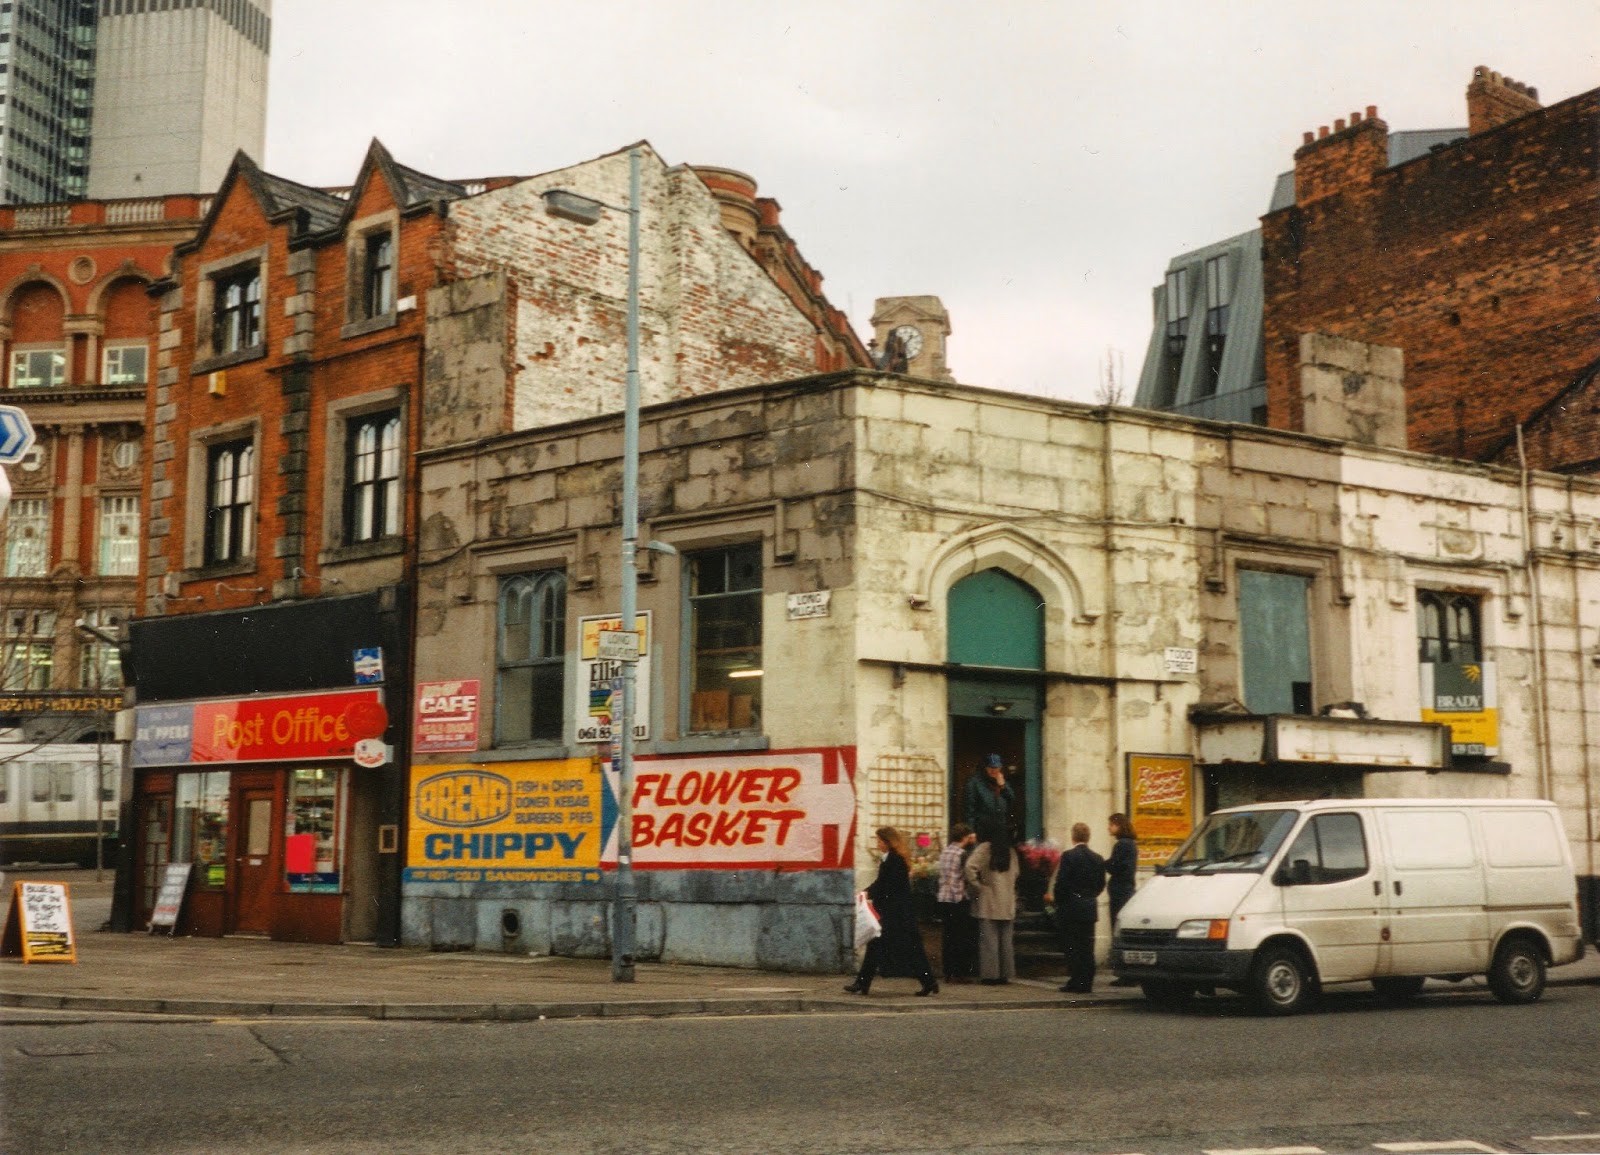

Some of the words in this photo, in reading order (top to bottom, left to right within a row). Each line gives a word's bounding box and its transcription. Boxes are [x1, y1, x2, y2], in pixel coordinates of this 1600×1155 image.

[796, 593, 822, 606] LONG
[789, 603, 826, 616] MILLGATE
[612, 620, 623, 631] LE
[607, 634, 630, 645] LONG
[600, 646, 638, 658] MILLGATE
[1169, 649, 1193, 660] TODD
[1164, 659, 1194, 671] STREET
[418, 695, 476, 714] CAFE
[1436, 695, 1482, 708] BRADY
[212, 712, 265, 749] Post
[271, 708, 349, 745] Office
[578, 726, 597, 739] 061
[516, 781, 539, 792] FISH
[552, 779, 583, 791] CHIPS
[631, 768, 802, 808] FLOWER
[418, 774, 509, 823] ARENA
[516, 797, 549, 808] DONER
[554, 796, 589, 807] KEBAB
[515, 812, 564, 824] BURGERS
[570, 811, 593, 823] PIES
[631, 810, 806, 847] BASKET
[424, 832, 587, 860] CHIPPY
[485, 870, 582, 882] SANDWICHES
